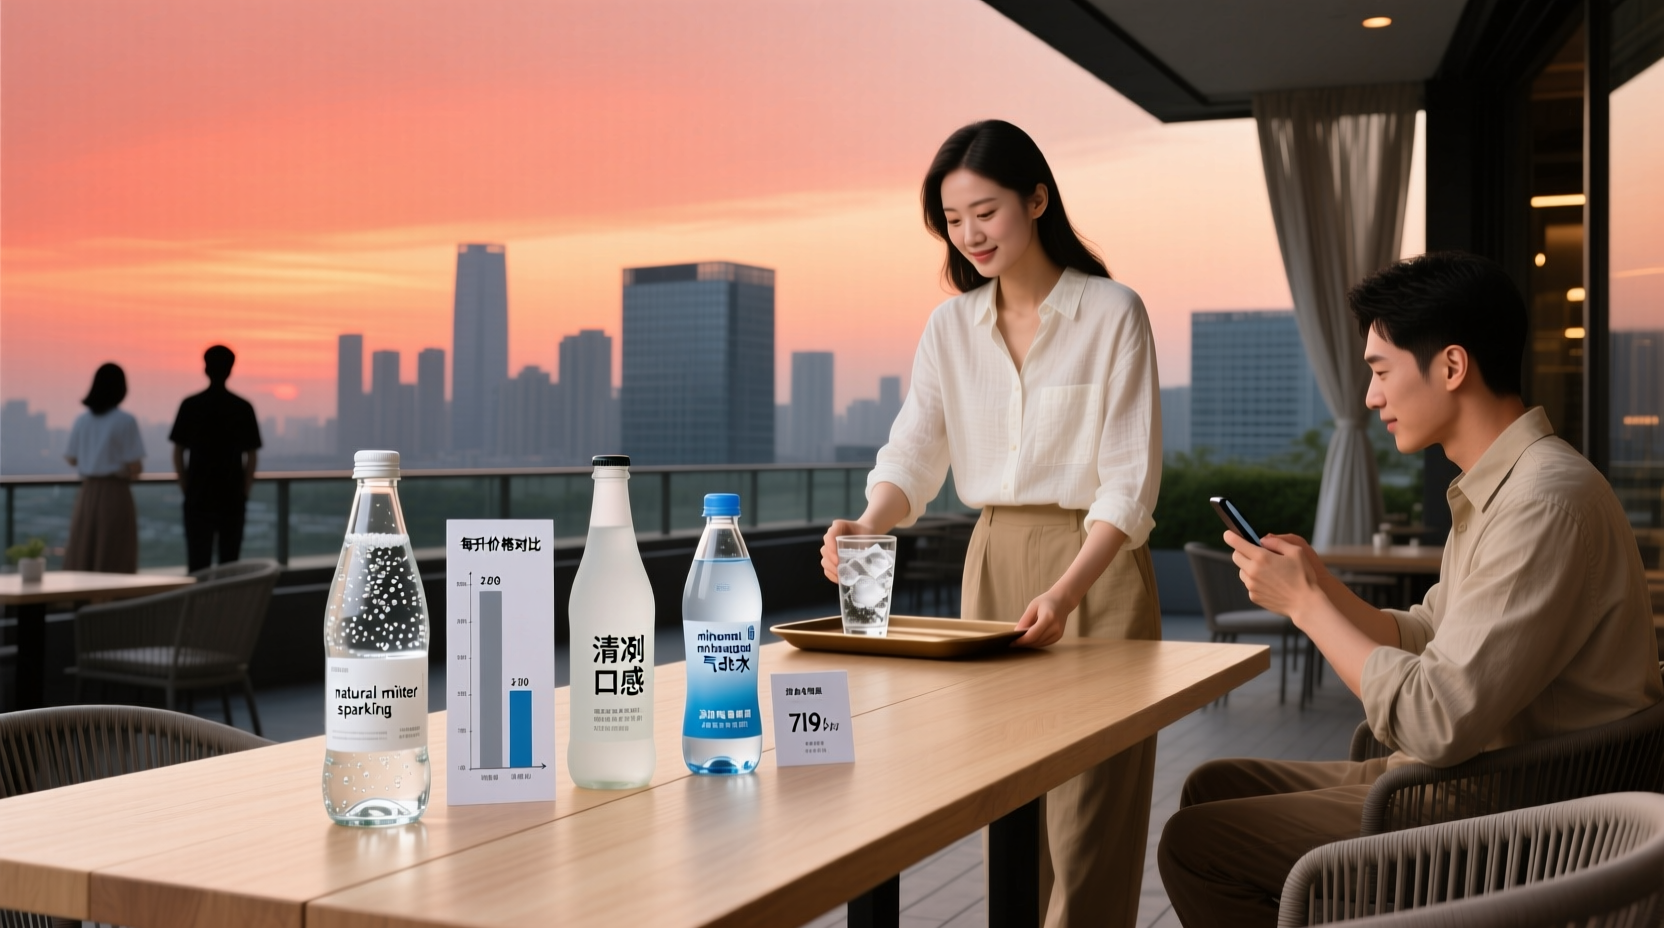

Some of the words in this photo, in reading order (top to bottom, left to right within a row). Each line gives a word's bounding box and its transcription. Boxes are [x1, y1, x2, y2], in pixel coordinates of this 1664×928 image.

[594, 665, 645, 696] 口感
[335, 685, 377, 699] natural
[788, 712, 821, 733] 719
